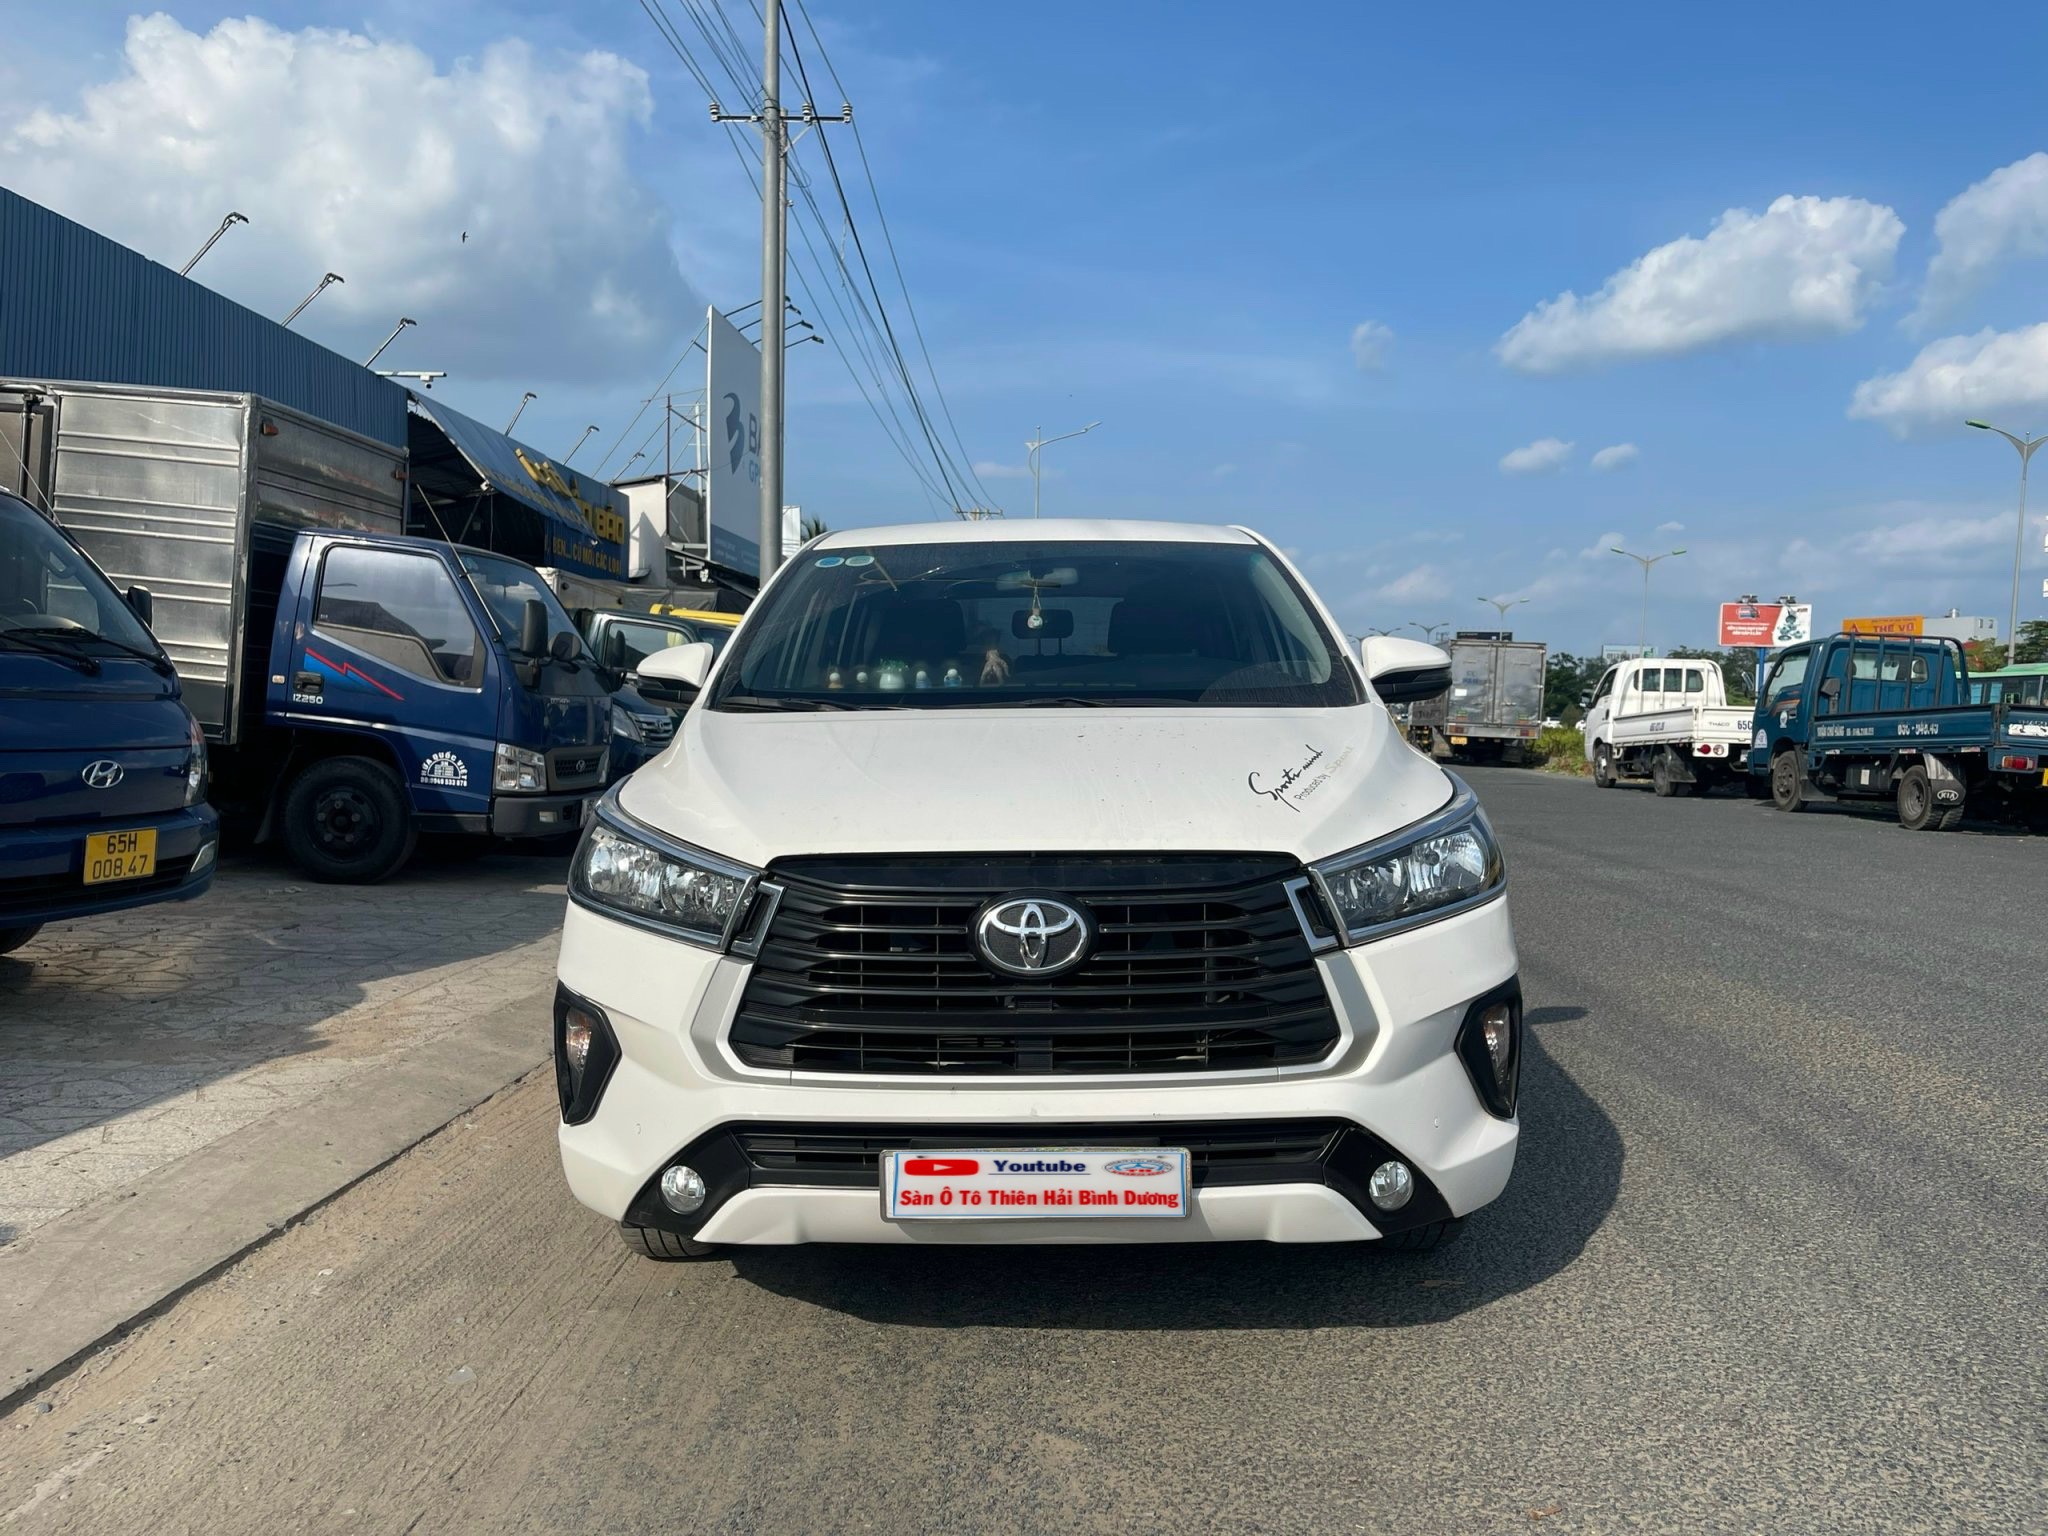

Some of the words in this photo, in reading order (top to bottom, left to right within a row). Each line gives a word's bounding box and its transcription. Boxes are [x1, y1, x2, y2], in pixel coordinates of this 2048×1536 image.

[292, 693, 324, 705] IZ250
[1939, 791, 1957, 799] KIA
[107, 832, 138, 855] 65H
[92, 854, 148, 880] 008.47
[993, 1160, 1086, 1173] Youtube
[900, 1188, 934, 1206] Sàn
[940, 1186, 953, 1206] Ô
[959, 1189, 982, 1206] Tô
[988, 1189, 1037, 1206] Thiên
[1043, 1187, 1073, 1206] Hải
[1081, 1188, 1118, 1206] Bình
[1124, 1189, 1179, 1209] Dương
